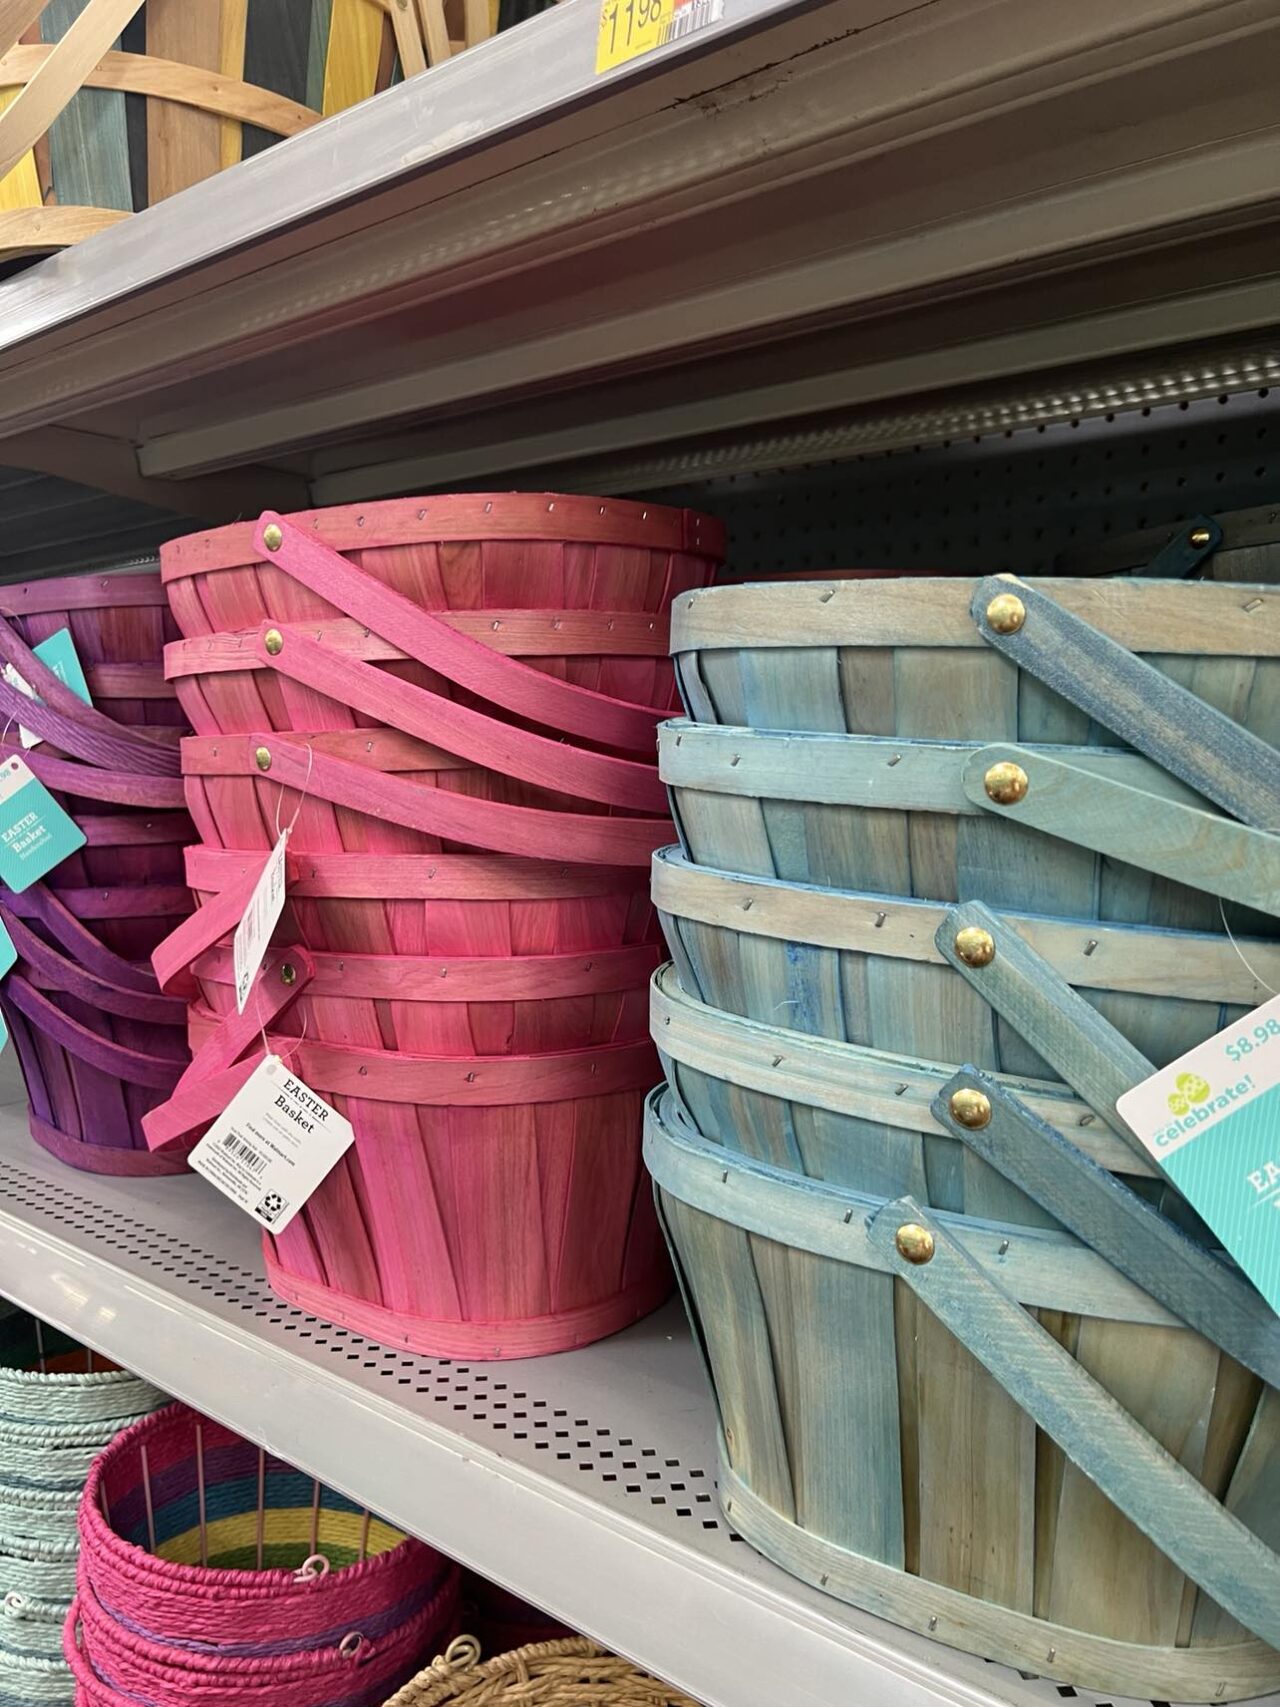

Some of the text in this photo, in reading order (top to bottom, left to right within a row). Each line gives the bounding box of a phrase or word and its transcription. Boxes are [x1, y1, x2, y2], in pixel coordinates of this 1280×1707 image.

[1, 811, 38, 842] EASTER
[12, 825, 46, 853] Basket
[1225, 1017, 1280, 1062] $8.98
[274, 1095, 315, 1134] Basket
[283, 1079, 329, 1122] EASTER
[1155, 1074, 1256, 1147] celebrate!
[245, 1122, 256, 1132] Find
[254, 1131, 265, 1141] more
[268, 1143, 296, 1166] Walmart.com
